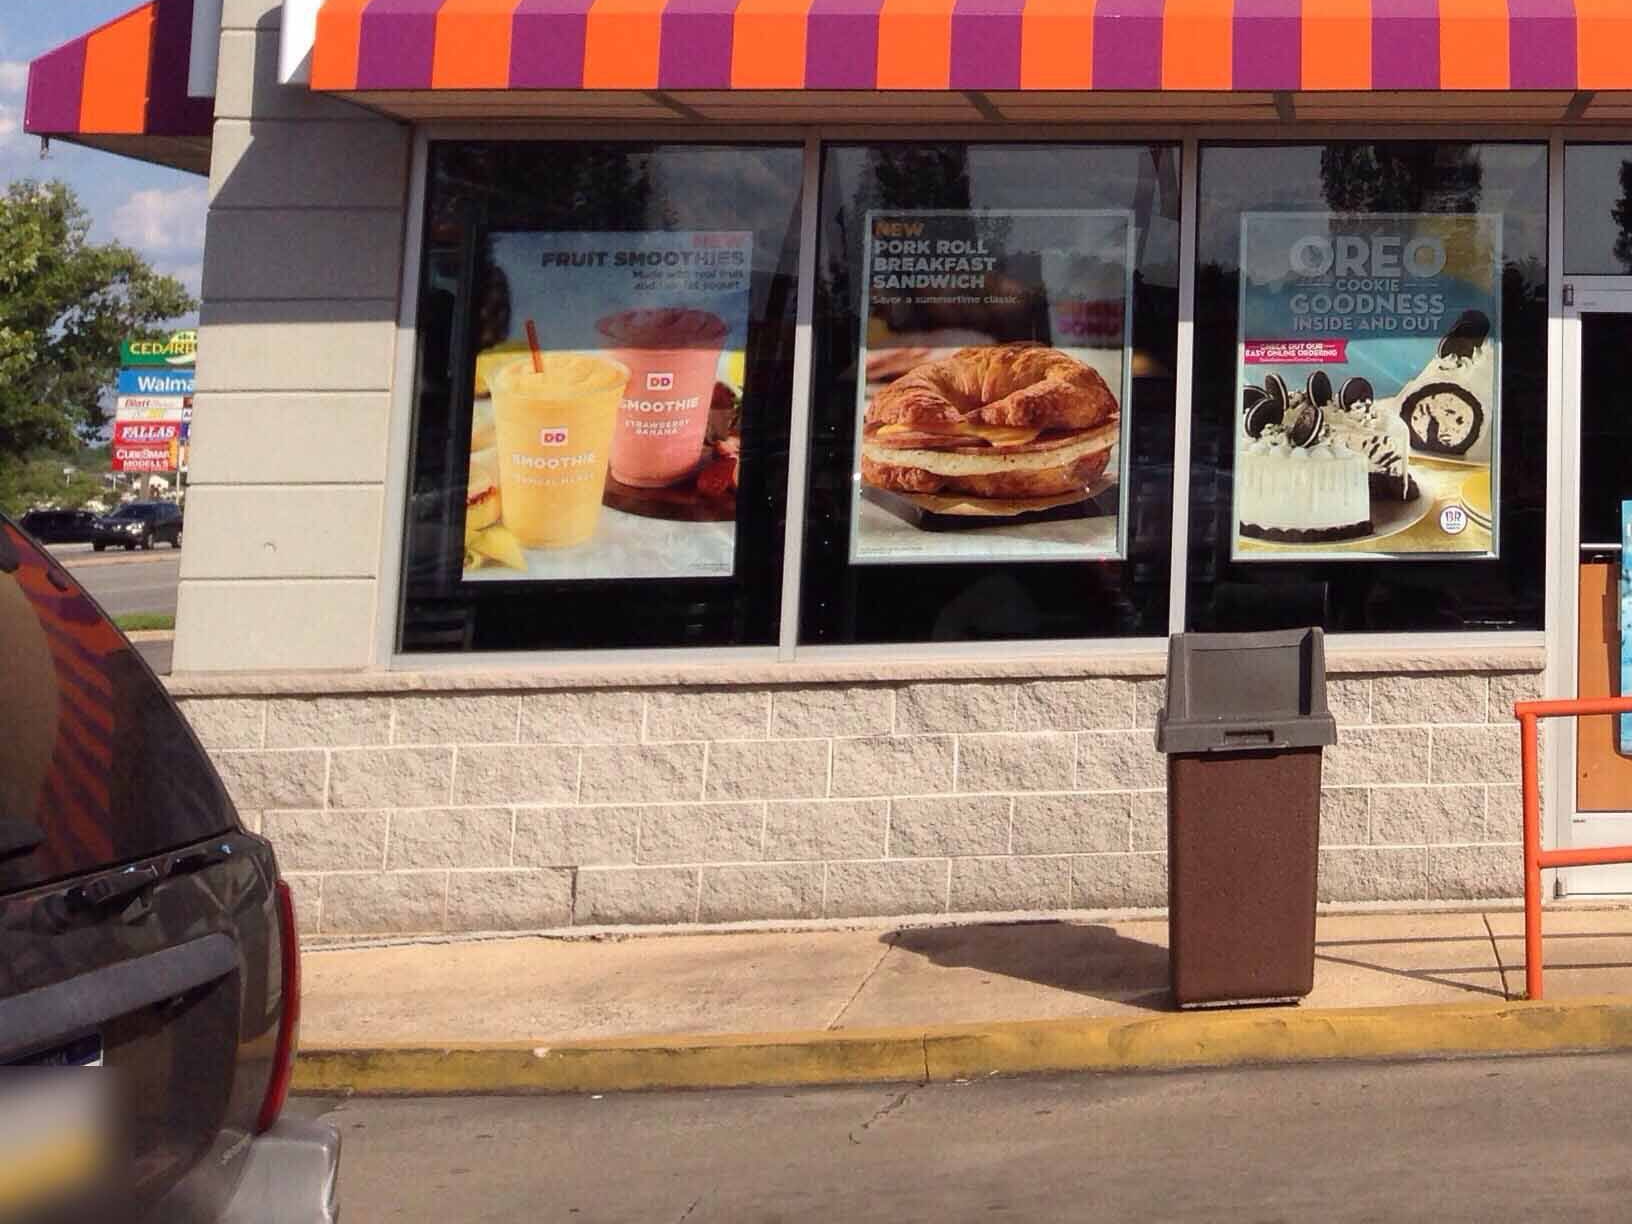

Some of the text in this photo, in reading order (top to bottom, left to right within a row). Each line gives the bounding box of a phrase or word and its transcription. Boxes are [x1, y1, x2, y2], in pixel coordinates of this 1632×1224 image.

[875, 222, 925, 237] NEW
[874, 239, 988, 254] PORK ROLL
[541, 251, 744, 267] FRUIT SMOOTHIES
[1290, 235, 1446, 277] OREO
[873, 257, 996, 271] BREAKFAST
[872, 274, 985, 288] SANDWICH
[1336, 279, 1400, 292] COOKIE
[1290, 294, 1444, 314] GOODNESS
[1294, 316, 1440, 331] INSIDE AND OUT
[137, 376, 195, 392] Walma
[650, 377, 671, 387] DD
[122, 426, 175, 441] FALLAS
[544, 433, 566, 443] DD
